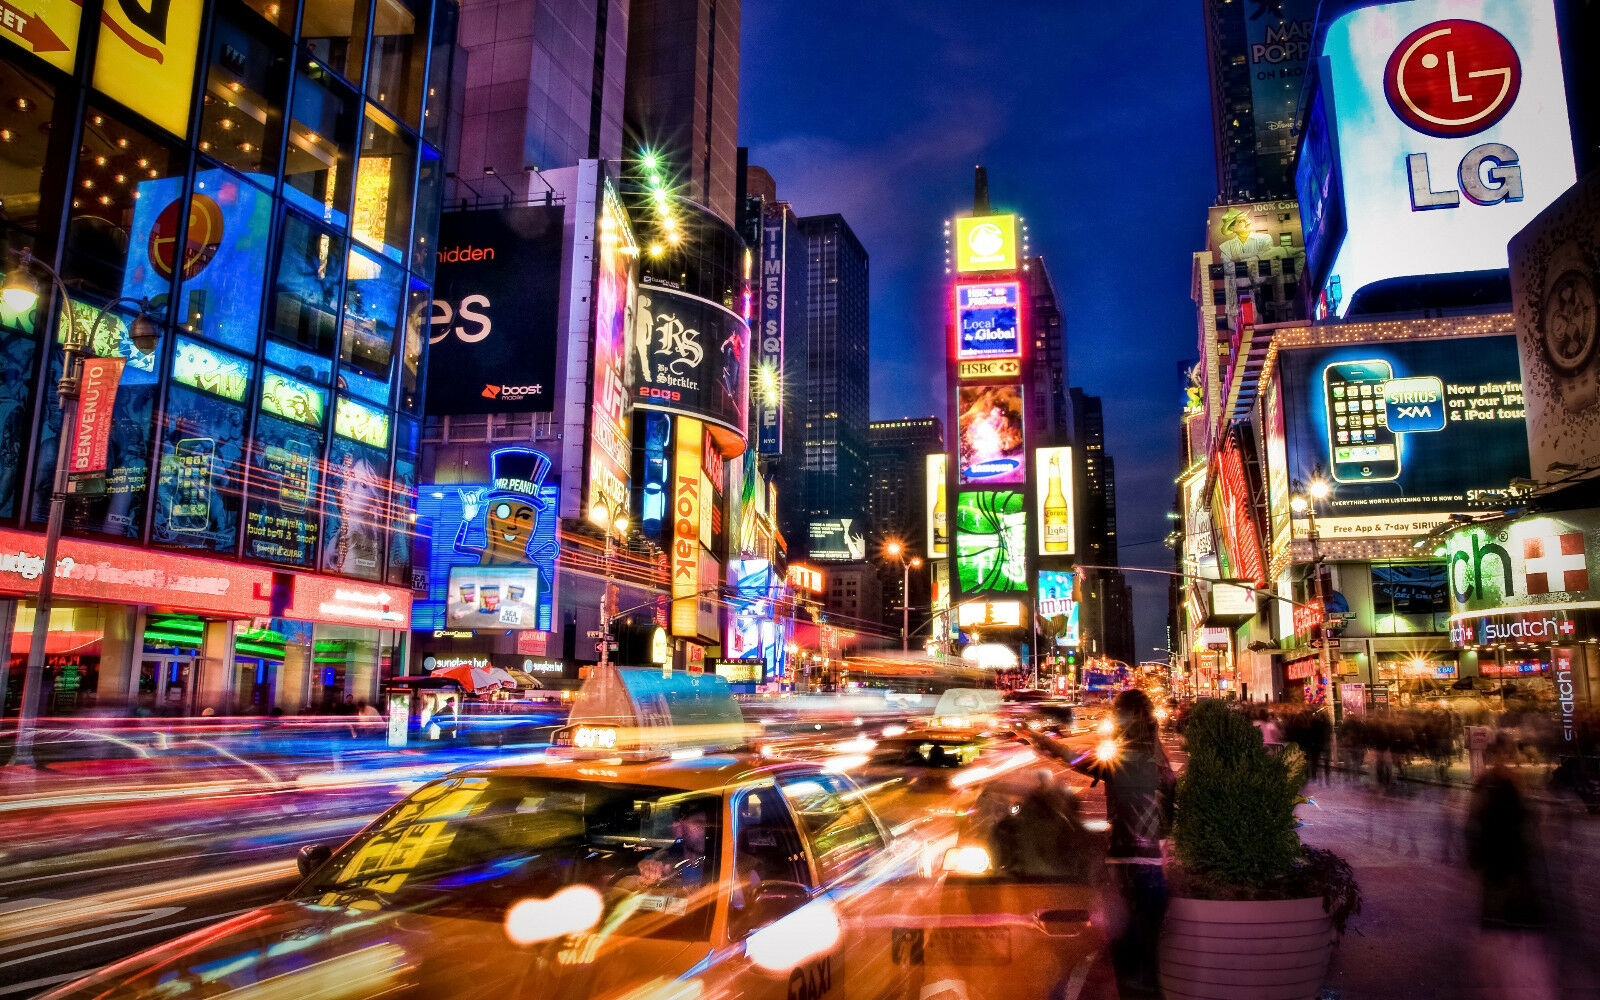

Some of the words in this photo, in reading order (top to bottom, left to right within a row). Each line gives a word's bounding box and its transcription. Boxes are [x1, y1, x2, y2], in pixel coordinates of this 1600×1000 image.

[1406, 143, 1524, 212] LG
[764, 226, 781, 310] TIMES
[963, 317, 996, 330] Local
[975, 327, 1016, 341] Global
[961, 362, 998, 374] HSBC
[501, 384, 543, 396] boost
[639, 386, 681, 401] 2009
[1447, 384, 1476, 395] Now
[1391, 391, 1437, 405] SIRIUS
[1449, 399, 1466, 408] on
[1469, 396, 1500, 409] your
[75, 366, 104, 469] BENVENUTO
[1396, 405, 1432, 419] XM
[1450, 411, 1462, 421] &
[1465, 409, 1495, 421] iPod
[508, 478, 539, 497] PEANUT
[676, 475, 698, 579] Kodak
[1046, 525, 1067, 536] Light
[1333, 525, 1353, 533] Free
[1355, 524, 1373, 533] App
[1374, 523, 1382, 531] &
[1384, 522, 1409, 533] 7-day
[502, 615, 519, 623] SALT
[504, 609, 517, 618] SEA
[1486, 616, 1559, 639] swatch
[474, 658, 488, 668] hut
